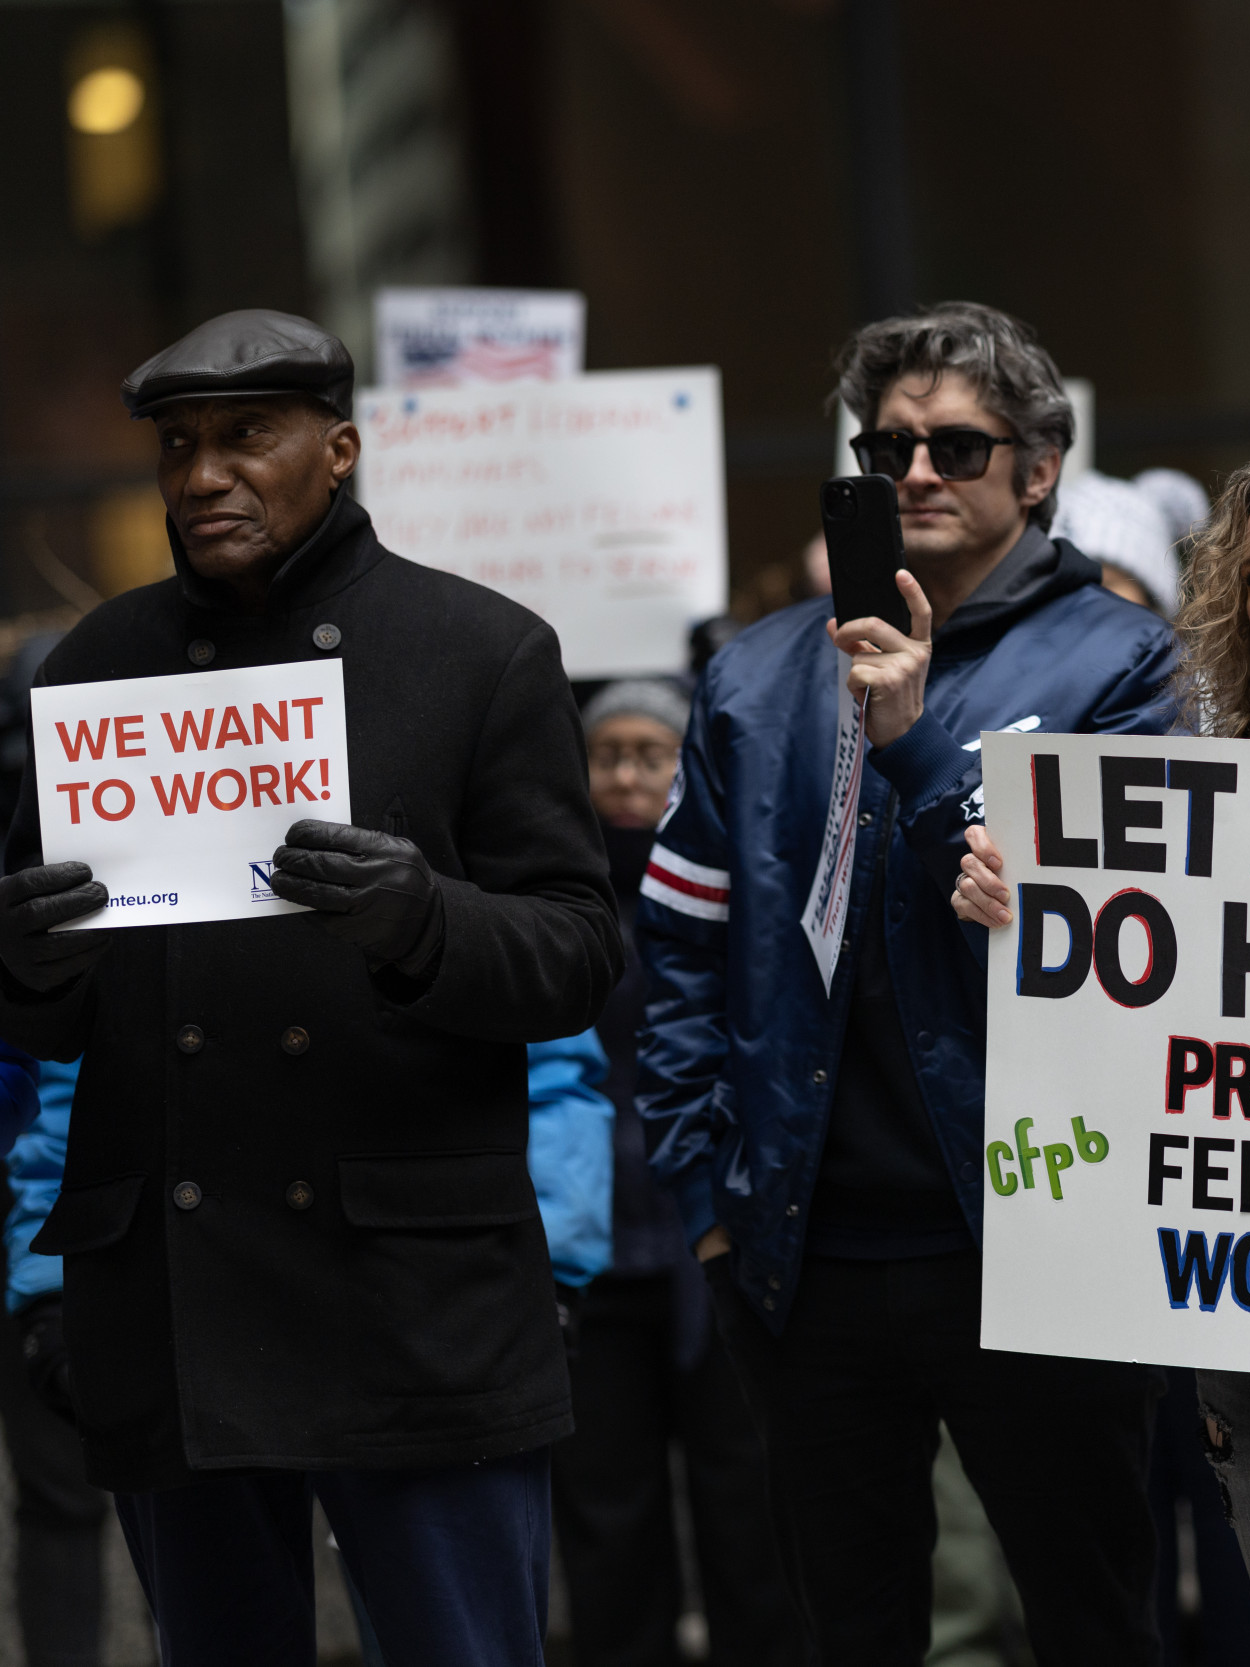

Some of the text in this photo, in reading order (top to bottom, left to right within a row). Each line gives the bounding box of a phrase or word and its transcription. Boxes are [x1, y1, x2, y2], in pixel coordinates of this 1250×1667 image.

[55, 697, 323, 762] WE WANT
[56, 758, 331, 824] TO WORK!
[1030, 753, 1238, 877] LET
[1016, 882, 1178, 1009] DO
[986, 1117, 1109, 1200] cfpb
